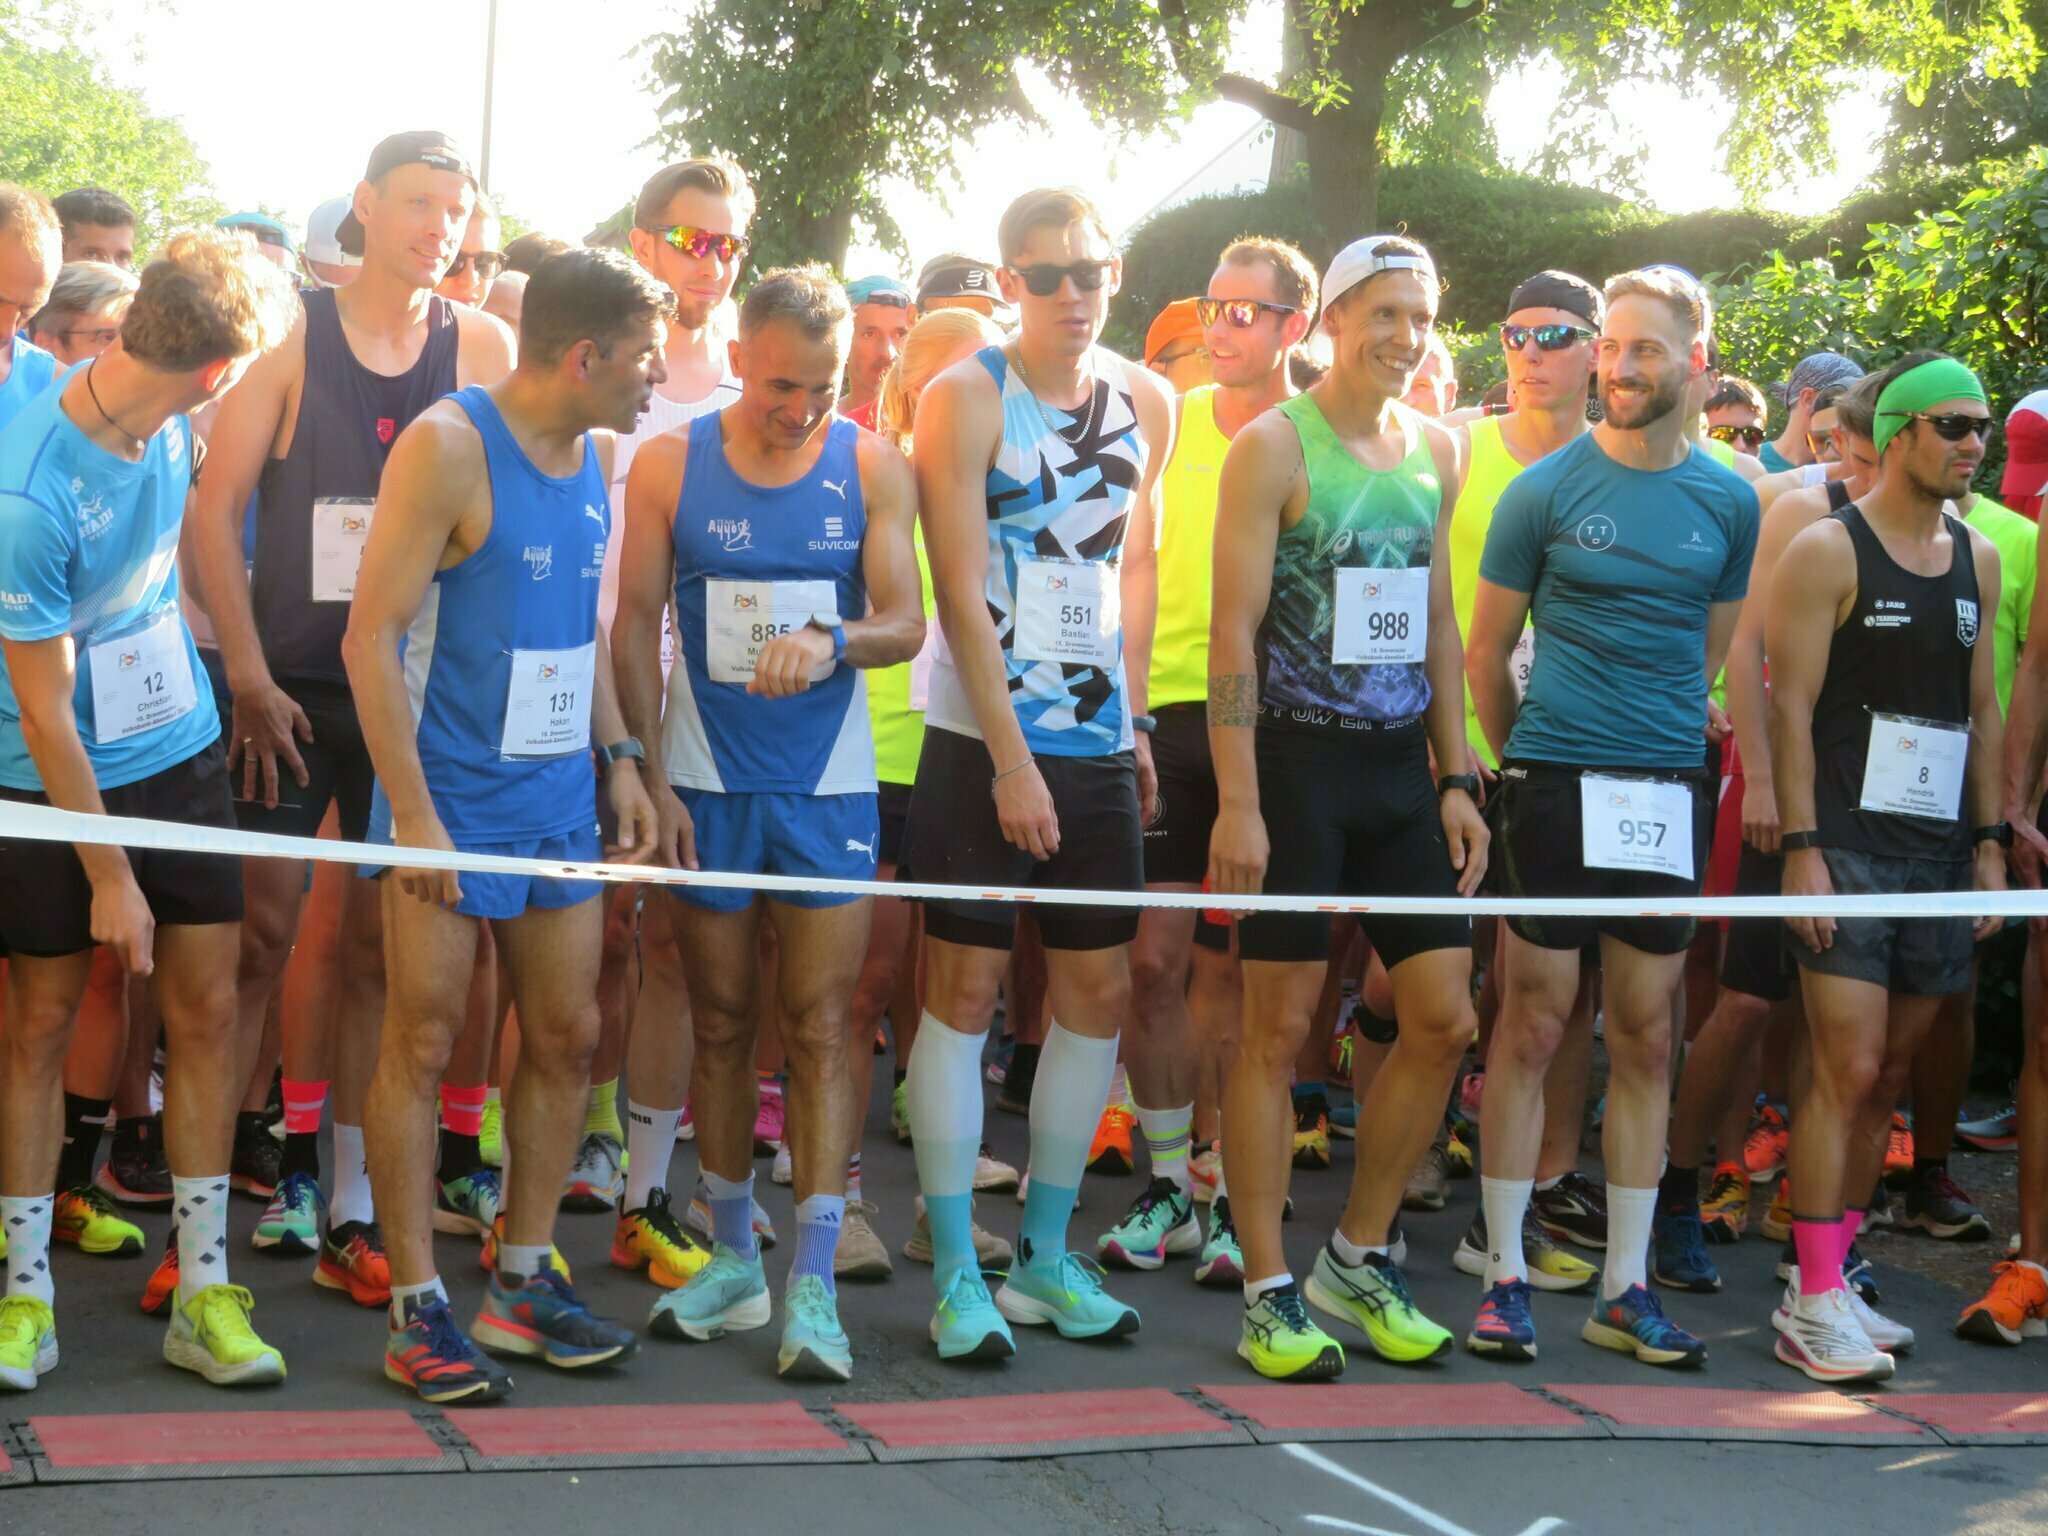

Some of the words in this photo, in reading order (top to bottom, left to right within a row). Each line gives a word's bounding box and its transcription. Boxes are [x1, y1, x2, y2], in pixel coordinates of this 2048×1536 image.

[808, 540, 859, 551] SUVICOM
[1885, 601, 1906, 609] JAKO
[1060, 605, 1092, 625] 551
[1061, 629, 1091, 638] Bastian
[1368, 611, 1410, 641] 988
[144, 671, 165, 695] 12
[137, 694, 173, 712] Christian
[550, 691, 575, 713] 131
[549, 717, 571, 727] Hakan
[1918, 766, 1929, 784] 8
[1906, 787, 1935, 798] Hendrik
[1618, 819, 1667, 848] 957
